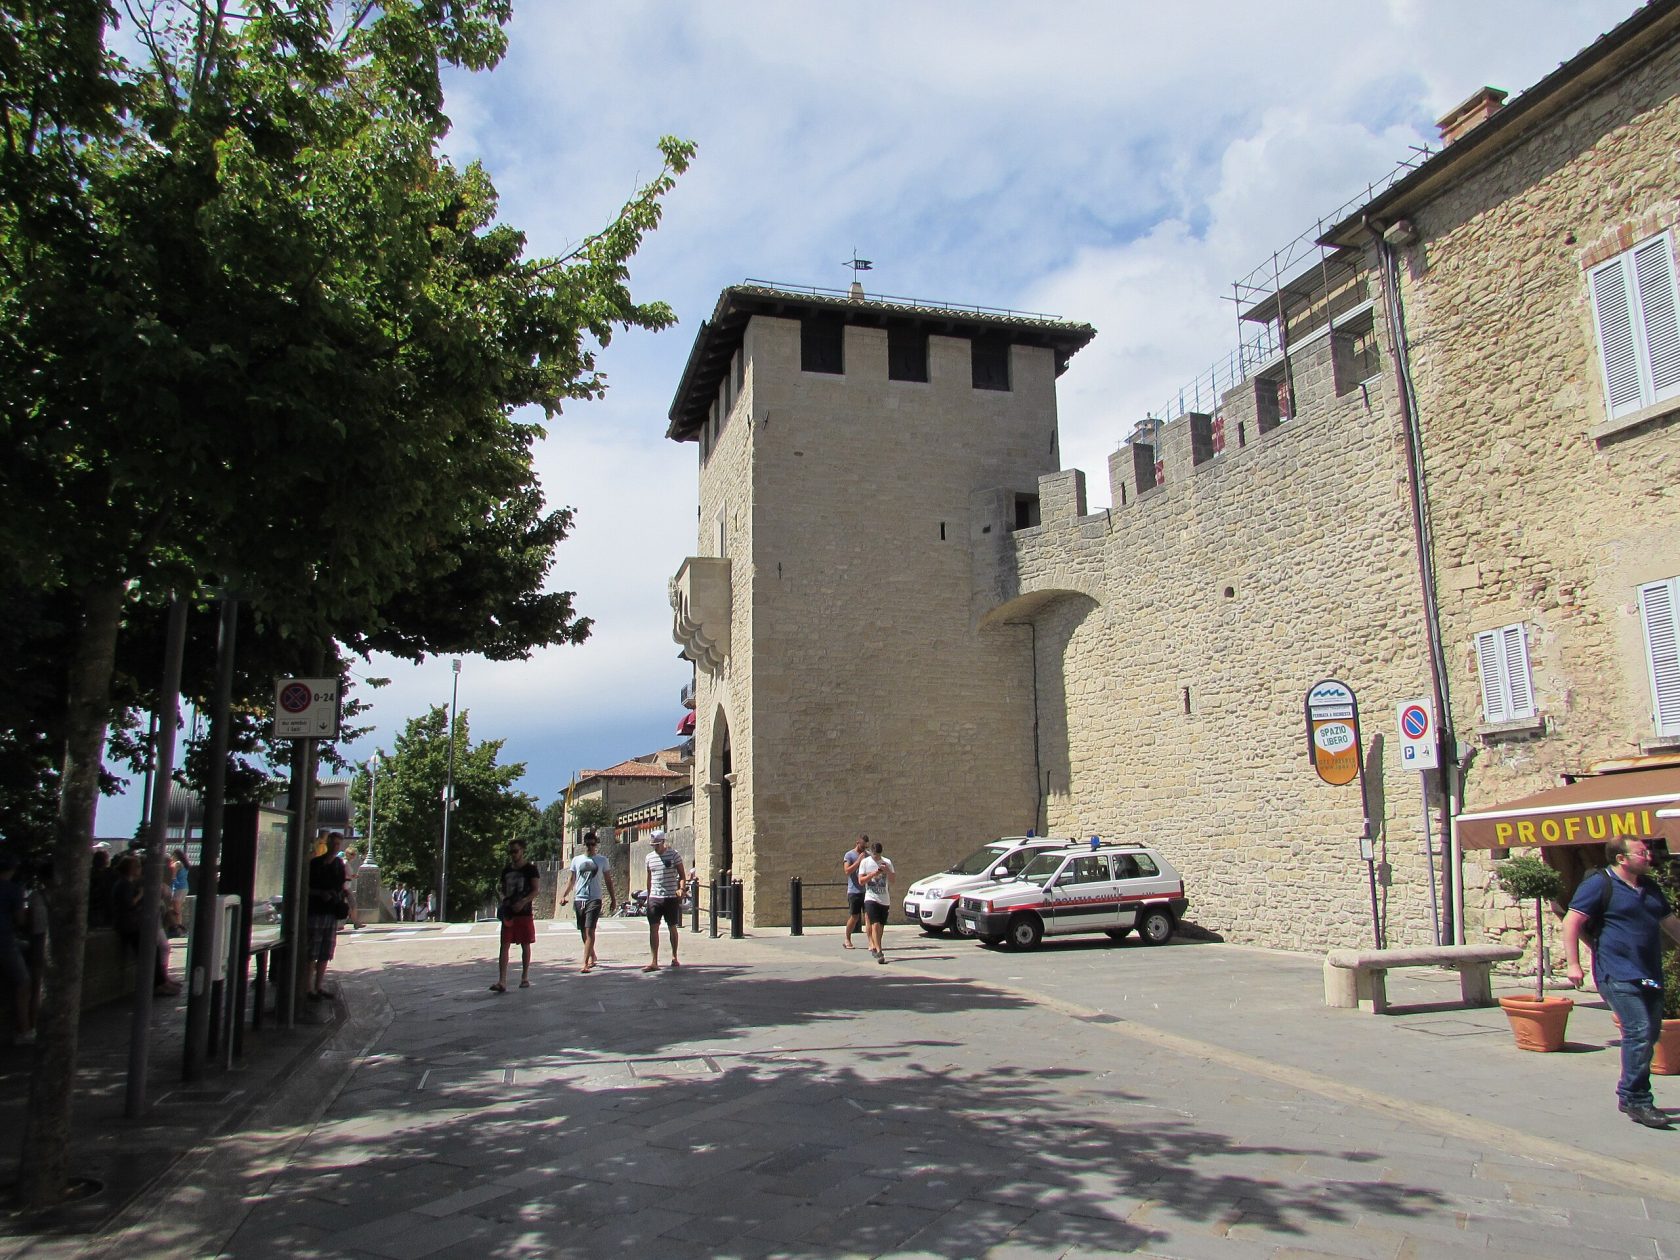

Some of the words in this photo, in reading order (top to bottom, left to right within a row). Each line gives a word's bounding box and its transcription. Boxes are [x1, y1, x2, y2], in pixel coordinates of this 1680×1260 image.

[314, 693, 334, 702] 0-24
[1320, 725, 1346, 737] SPAZIO
[1322, 735, 1348, 747] LIBERO
[1406, 748, 1413, 758] P
[1495, 810, 1651, 845] PROFUMI
[1055, 895, 1092, 905] POLIZIA
